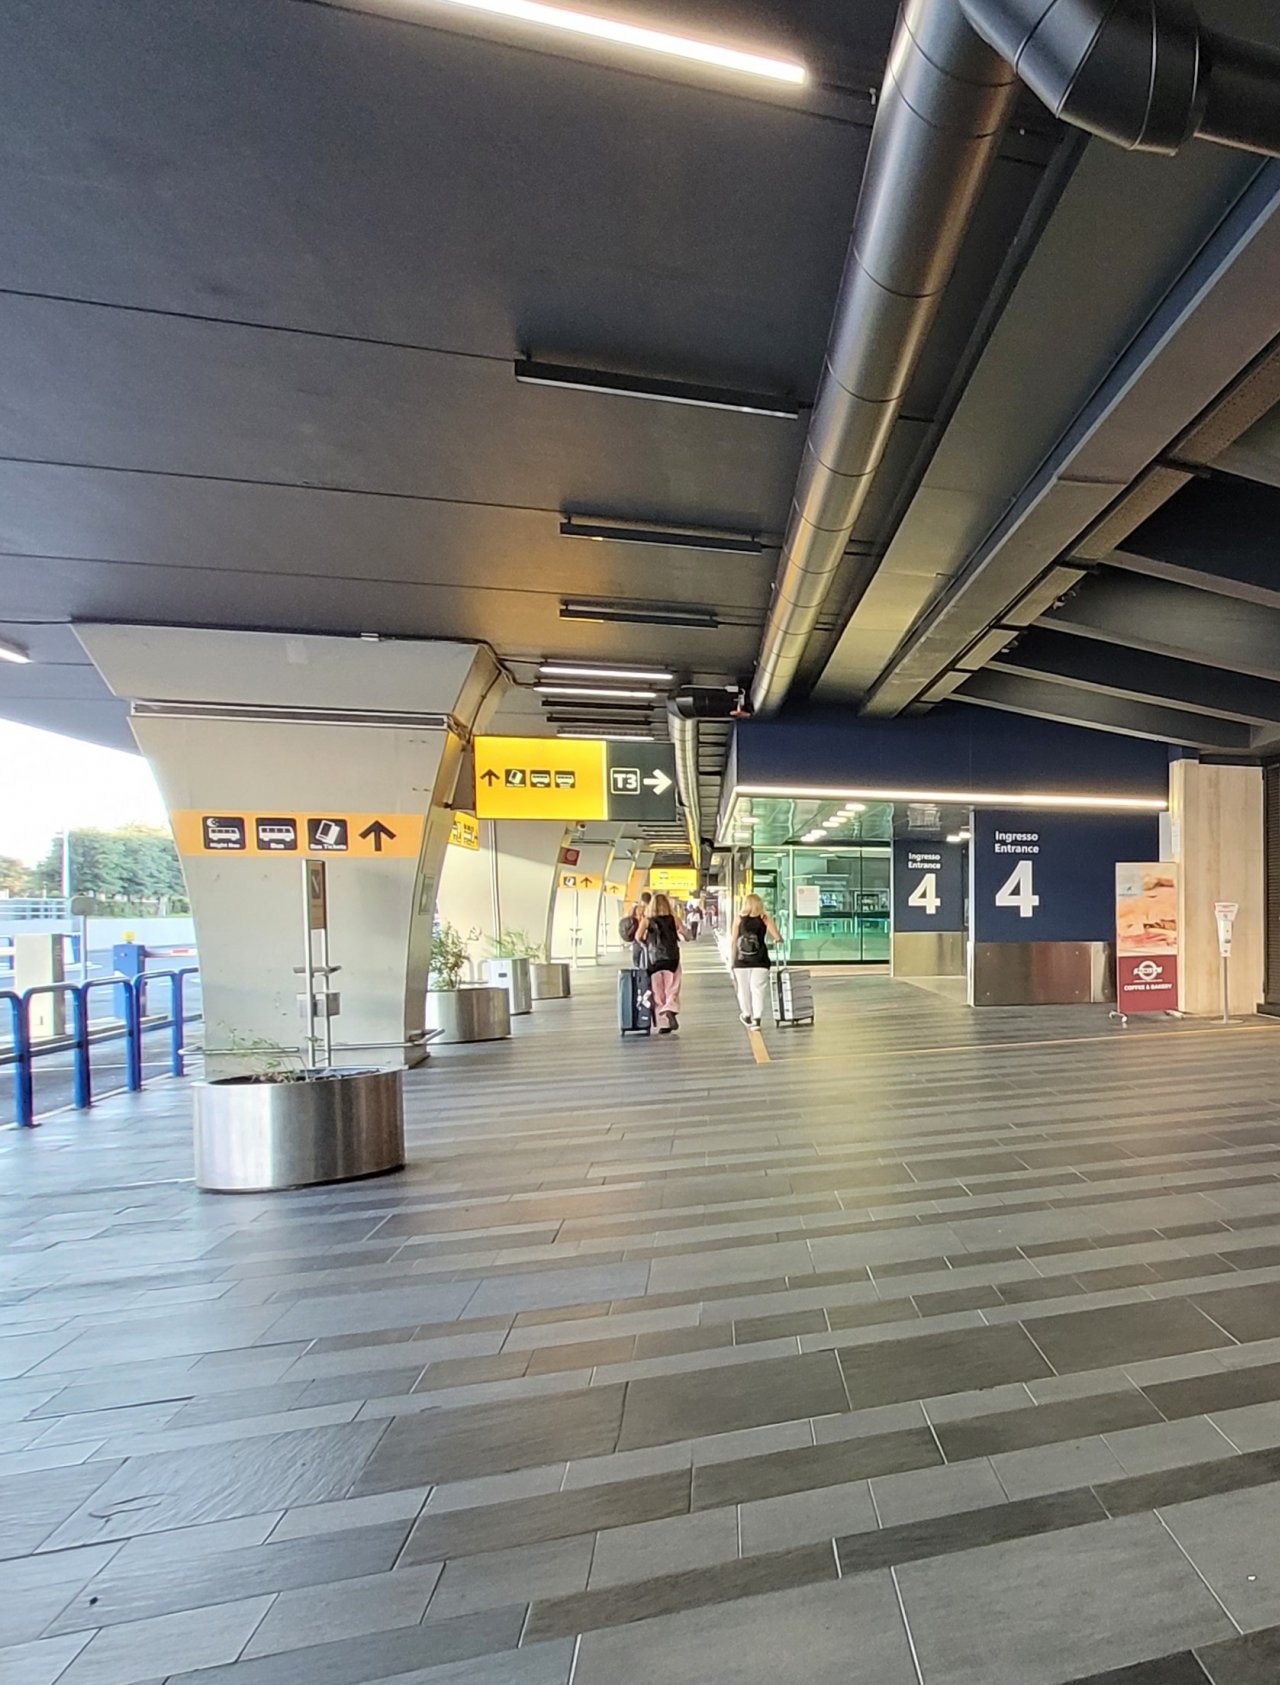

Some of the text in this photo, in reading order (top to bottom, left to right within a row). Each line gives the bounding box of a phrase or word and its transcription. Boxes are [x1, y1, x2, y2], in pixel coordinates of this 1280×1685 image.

[613, 774, 638, 789] T3
[995, 831, 1039, 843] Ingresso
[994, 844, 1039, 854] Entrance
[908, 852, 941, 861] Ingresso
[908, 861, 941, 869] Entrance
[908, 873, 941, 914] 4
[995, 860, 1039, 917] 4
